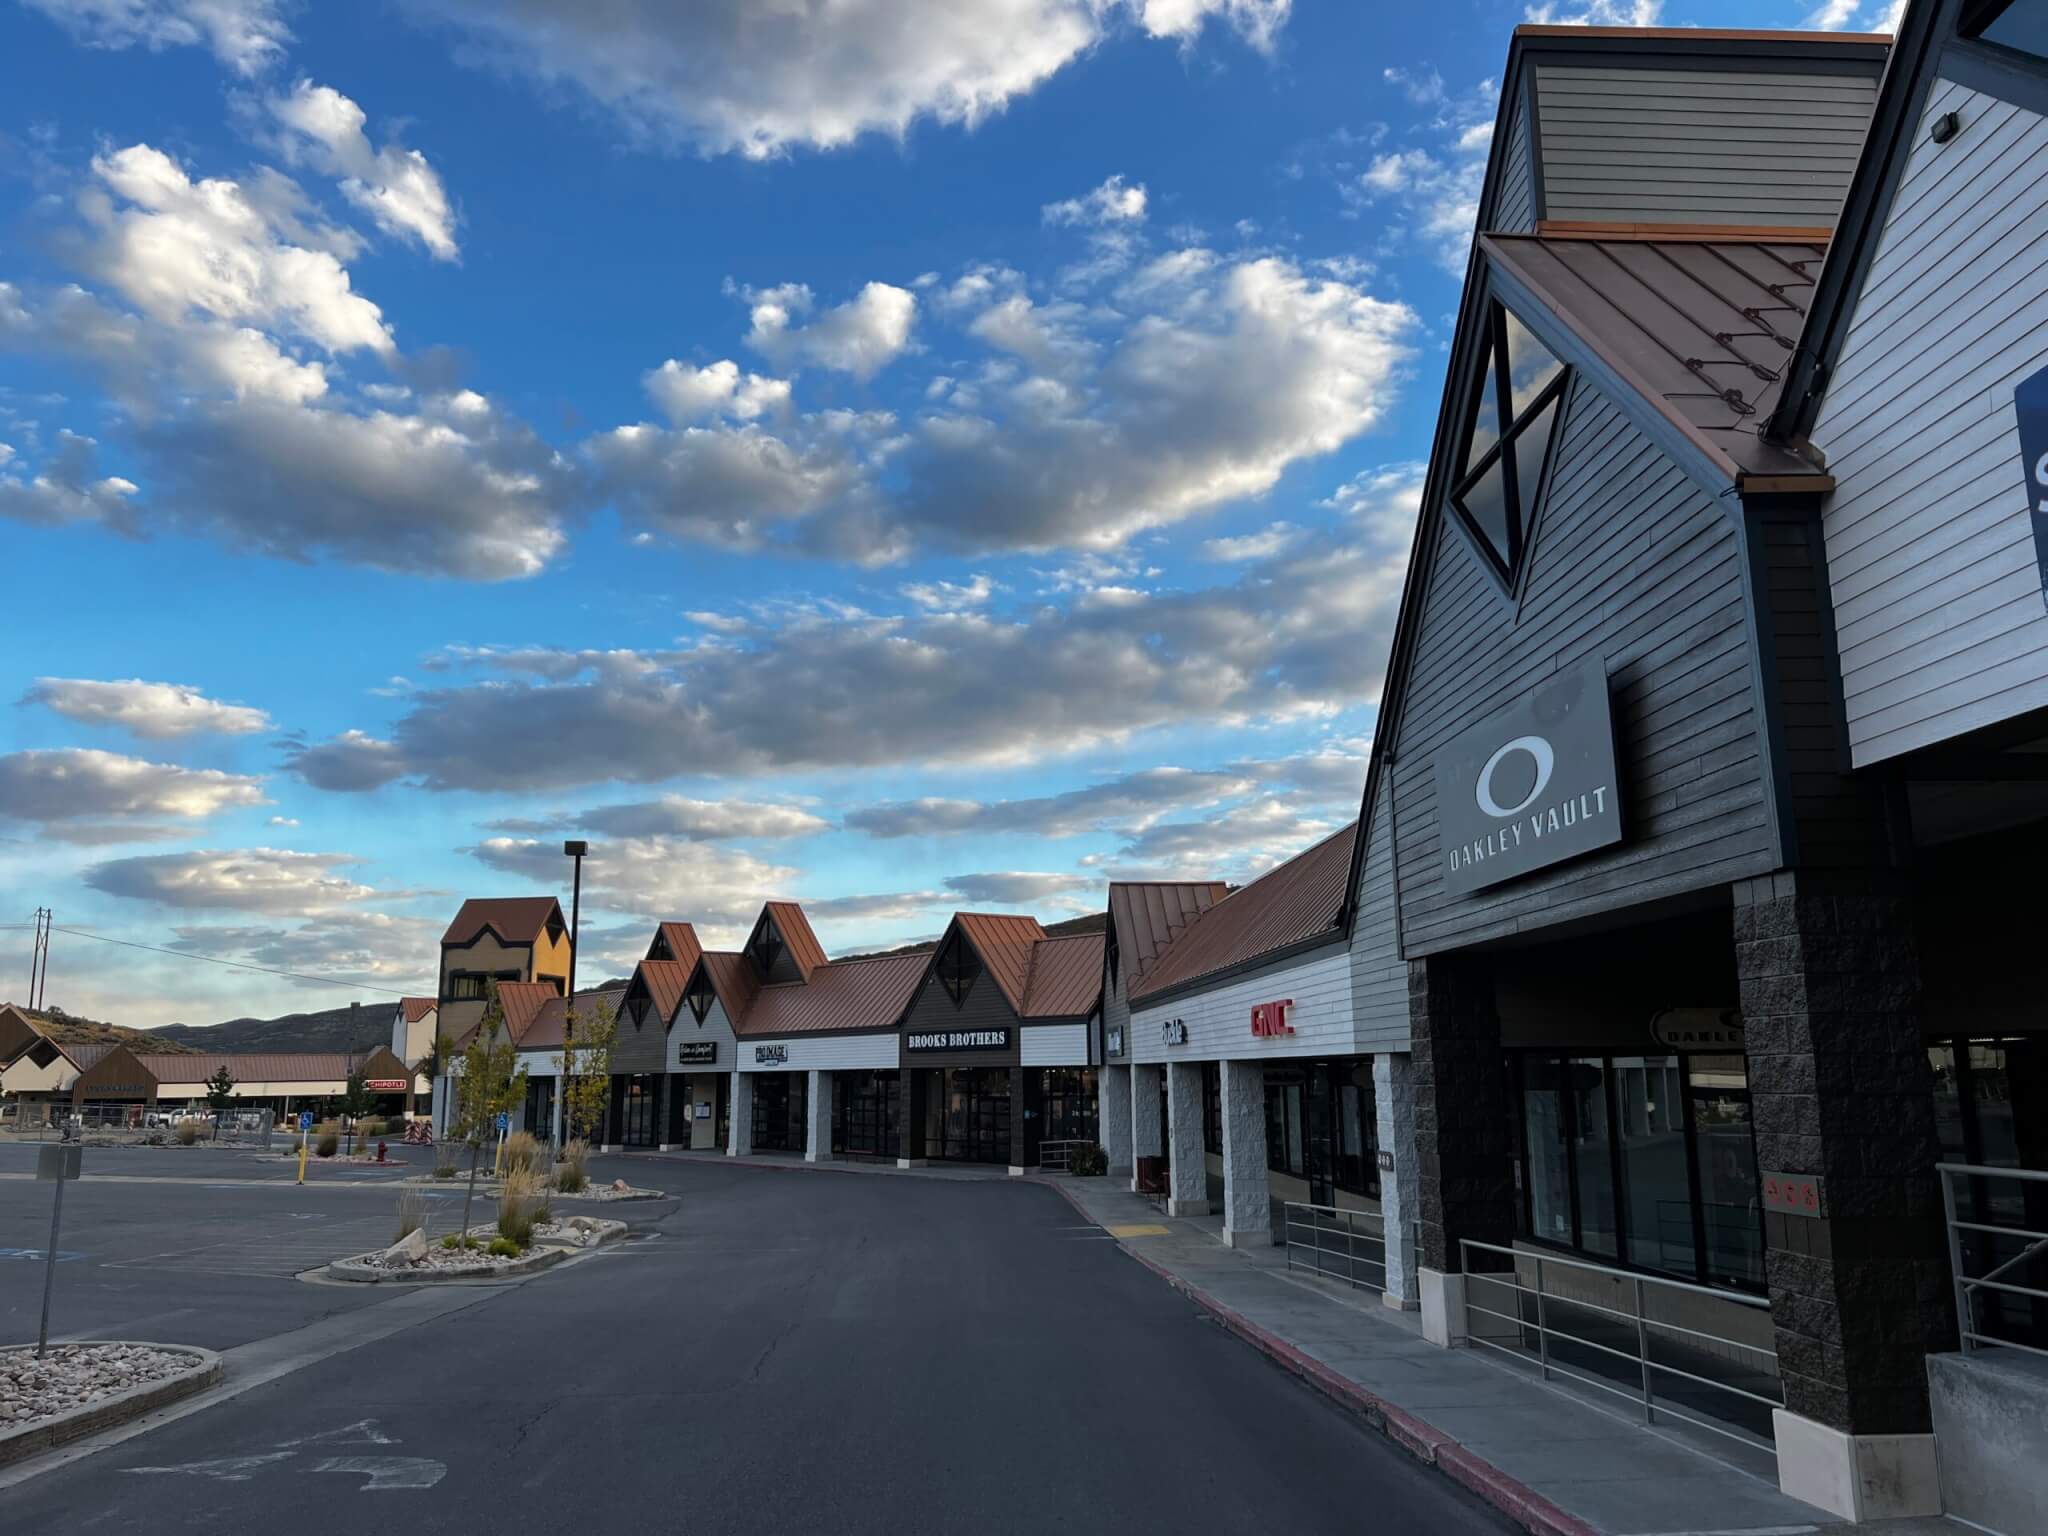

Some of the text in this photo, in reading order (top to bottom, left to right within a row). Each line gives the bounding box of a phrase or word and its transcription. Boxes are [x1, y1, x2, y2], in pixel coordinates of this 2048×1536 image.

[1450, 786, 1606, 872] OAKLEY VAULT
[1251, 999, 1294, 1037] GNC
[908, 1031, 1005, 1048] BROOKS BROTHERS
[1668, 1031, 1743, 1041] OAKLE
[370, 1081, 404, 1089] CHIPOTLE
